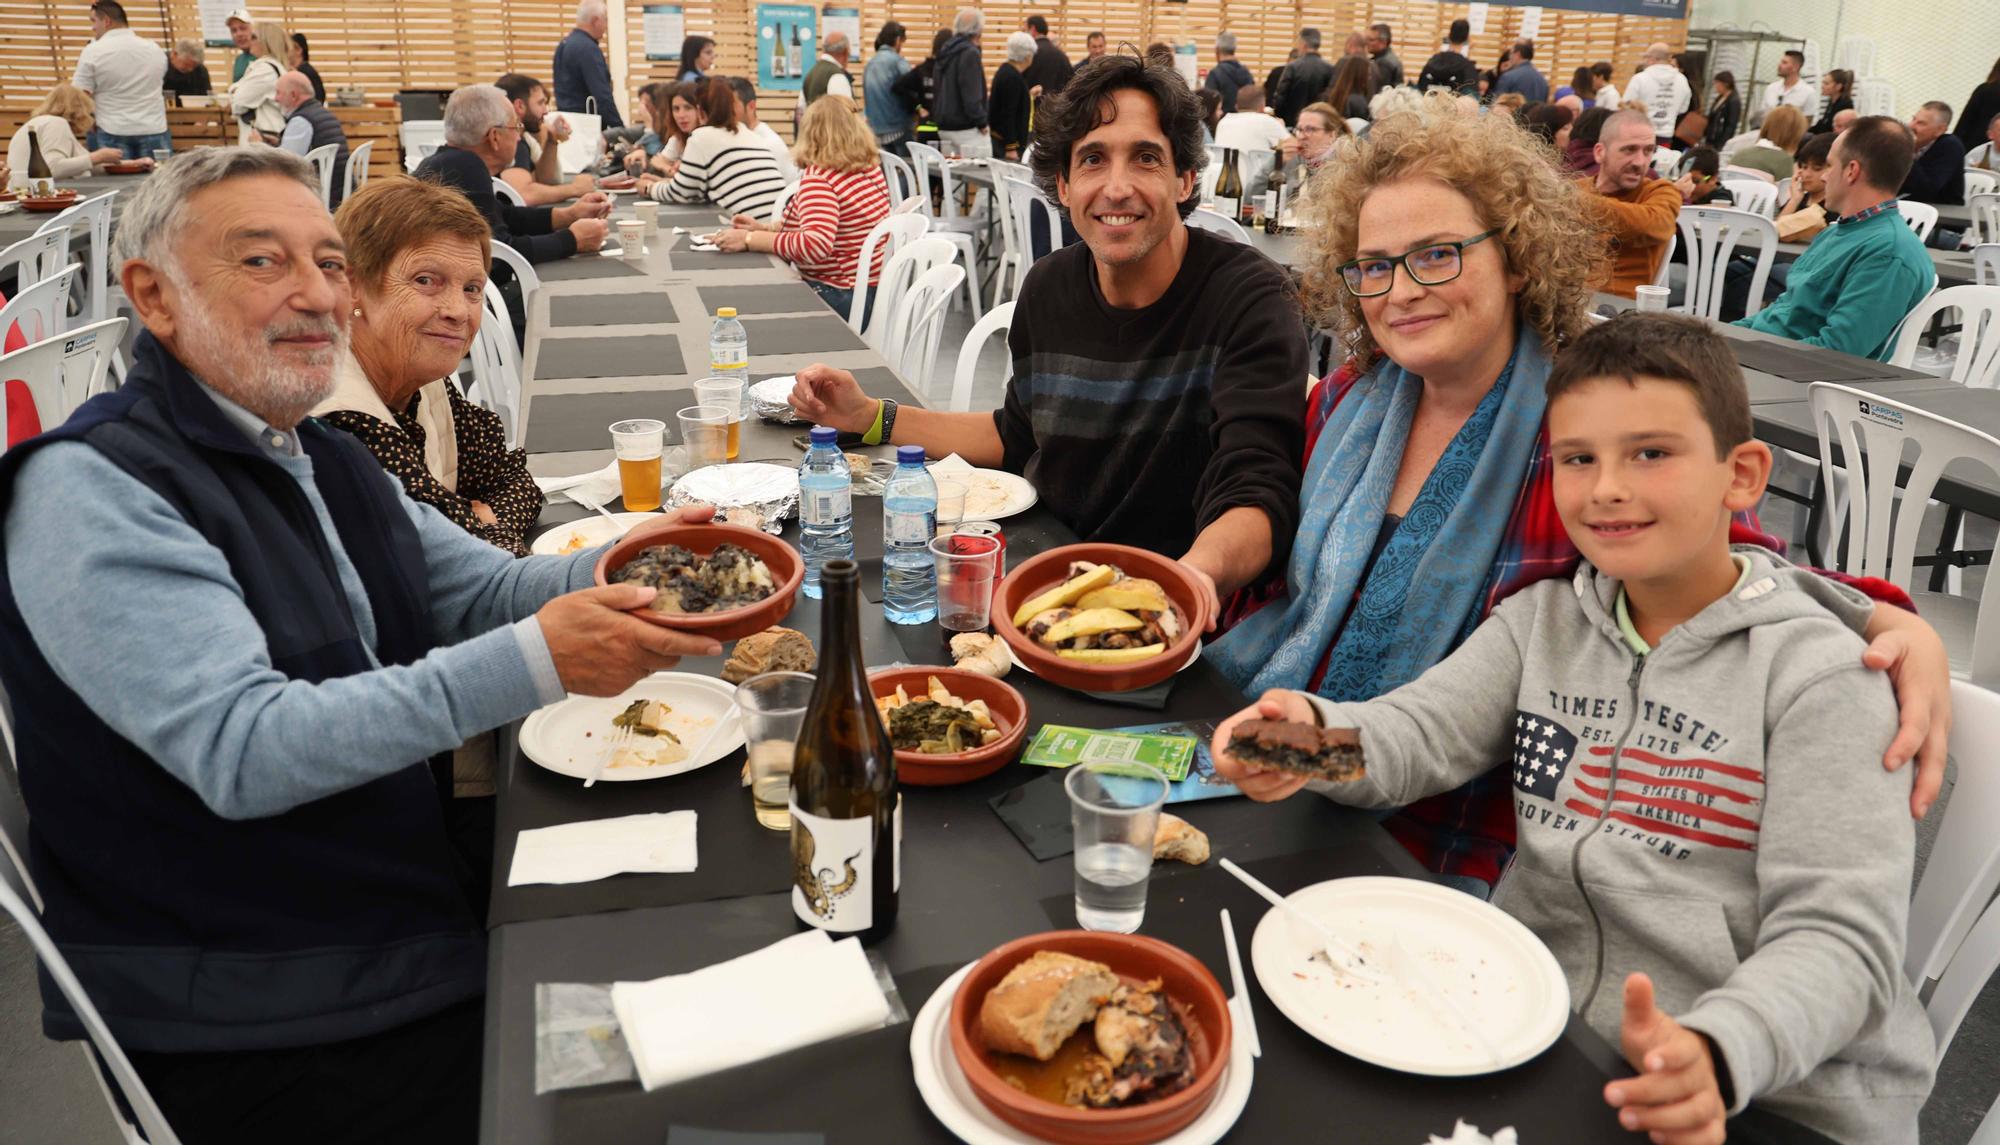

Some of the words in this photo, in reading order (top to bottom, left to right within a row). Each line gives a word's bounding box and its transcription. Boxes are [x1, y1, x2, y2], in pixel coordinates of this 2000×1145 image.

[1549, 690, 1618, 719] TIMES
[1644, 700, 1729, 753] TESTE
[1581, 726, 1614, 743] EST.
[1638, 733, 1680, 755] 1776
[1658, 765, 1705, 780] UNITED
[1641, 785, 1688, 801] STATES
[1696, 792, 1716, 808] OF
[1635, 803, 1701, 830] AMERICA
